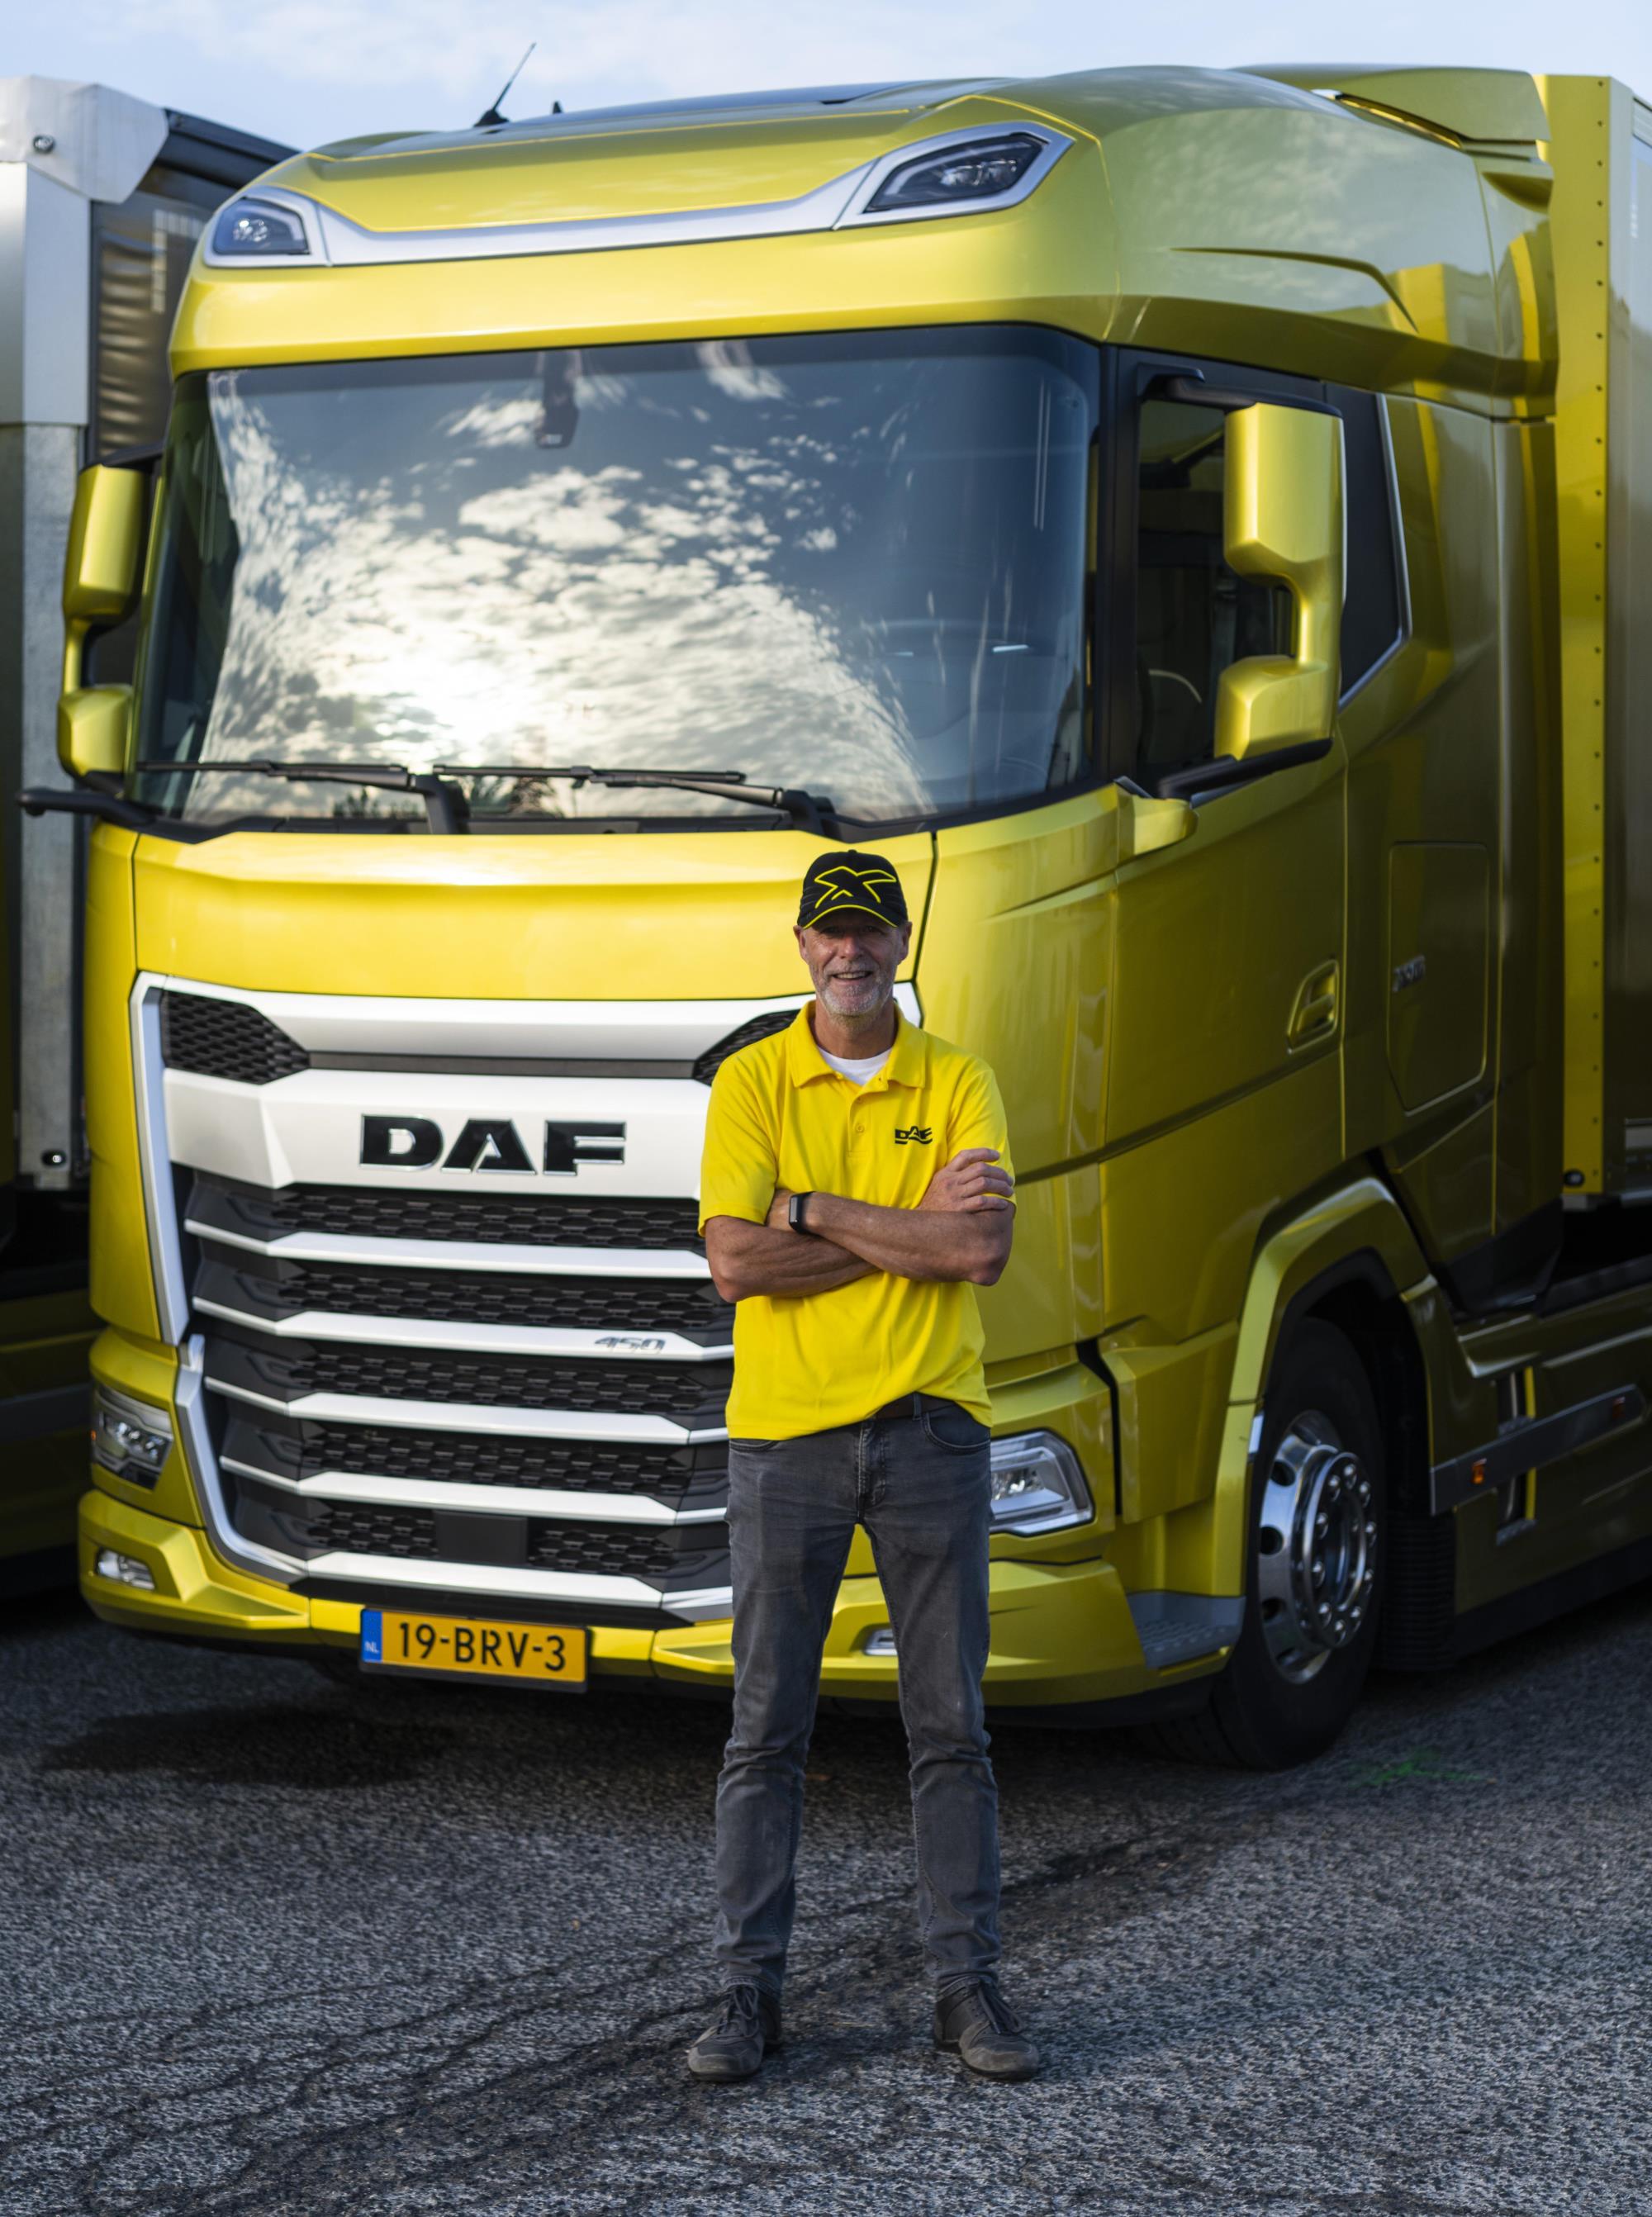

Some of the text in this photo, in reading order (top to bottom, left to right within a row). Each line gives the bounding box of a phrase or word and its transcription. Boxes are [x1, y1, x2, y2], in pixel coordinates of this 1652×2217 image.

[359, 1113, 626, 1176] DAF
[895, 1126, 933, 1142] DAF
[364, 1640, 379, 1654] NL
[399, 1621, 566, 1672] 19-BRV-3
